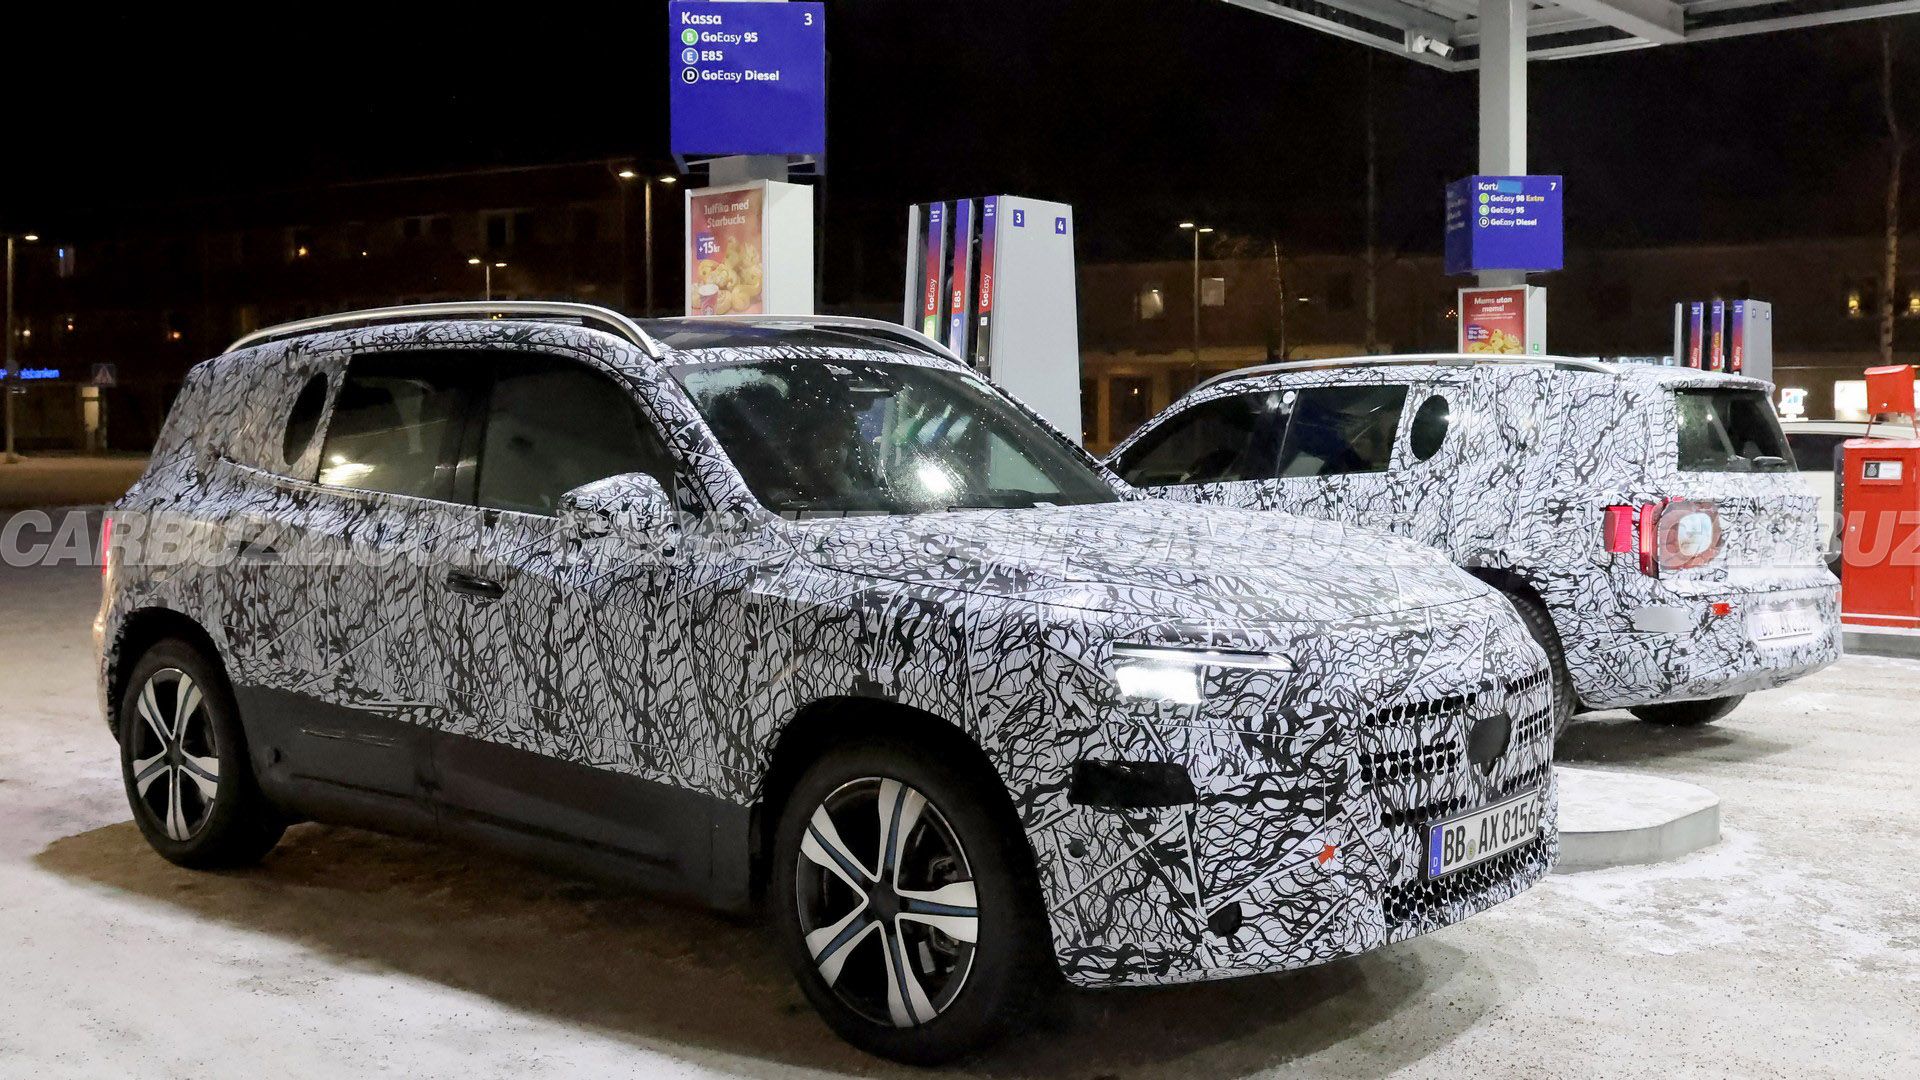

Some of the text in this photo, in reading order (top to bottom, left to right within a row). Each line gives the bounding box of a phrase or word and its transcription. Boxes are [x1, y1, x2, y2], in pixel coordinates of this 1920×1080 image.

[681, 12, 722, 25] Kassa
[804, 13, 813, 26] 3
[701, 32, 742, 45] GoEasy
[744, 32, 758, 43] 95
[701, 51, 723, 61] E85
[701, 70, 742, 83] GoEasy
[745, 70, 780, 81] Diesel
[1550, 182, 1557, 191] 7
[731, 199, 749, 211] med
[1490, 195, 1515, 203] GoEasy
[1490, 206, 1515, 215] GoEasy
[707, 214, 746, 228] Starbucks
[1016, 212, 1022, 223] 3
[1490, 218, 1515, 227] GoEasy
[1516, 218, 1537, 226] Diesel
[1057, 220, 1064, 231] 4
[927, 278, 937, 311] GoEasy
[982, 273, 991, 307] GoEasy
[1432, 798, 1536, 868] D BB AX 8156
